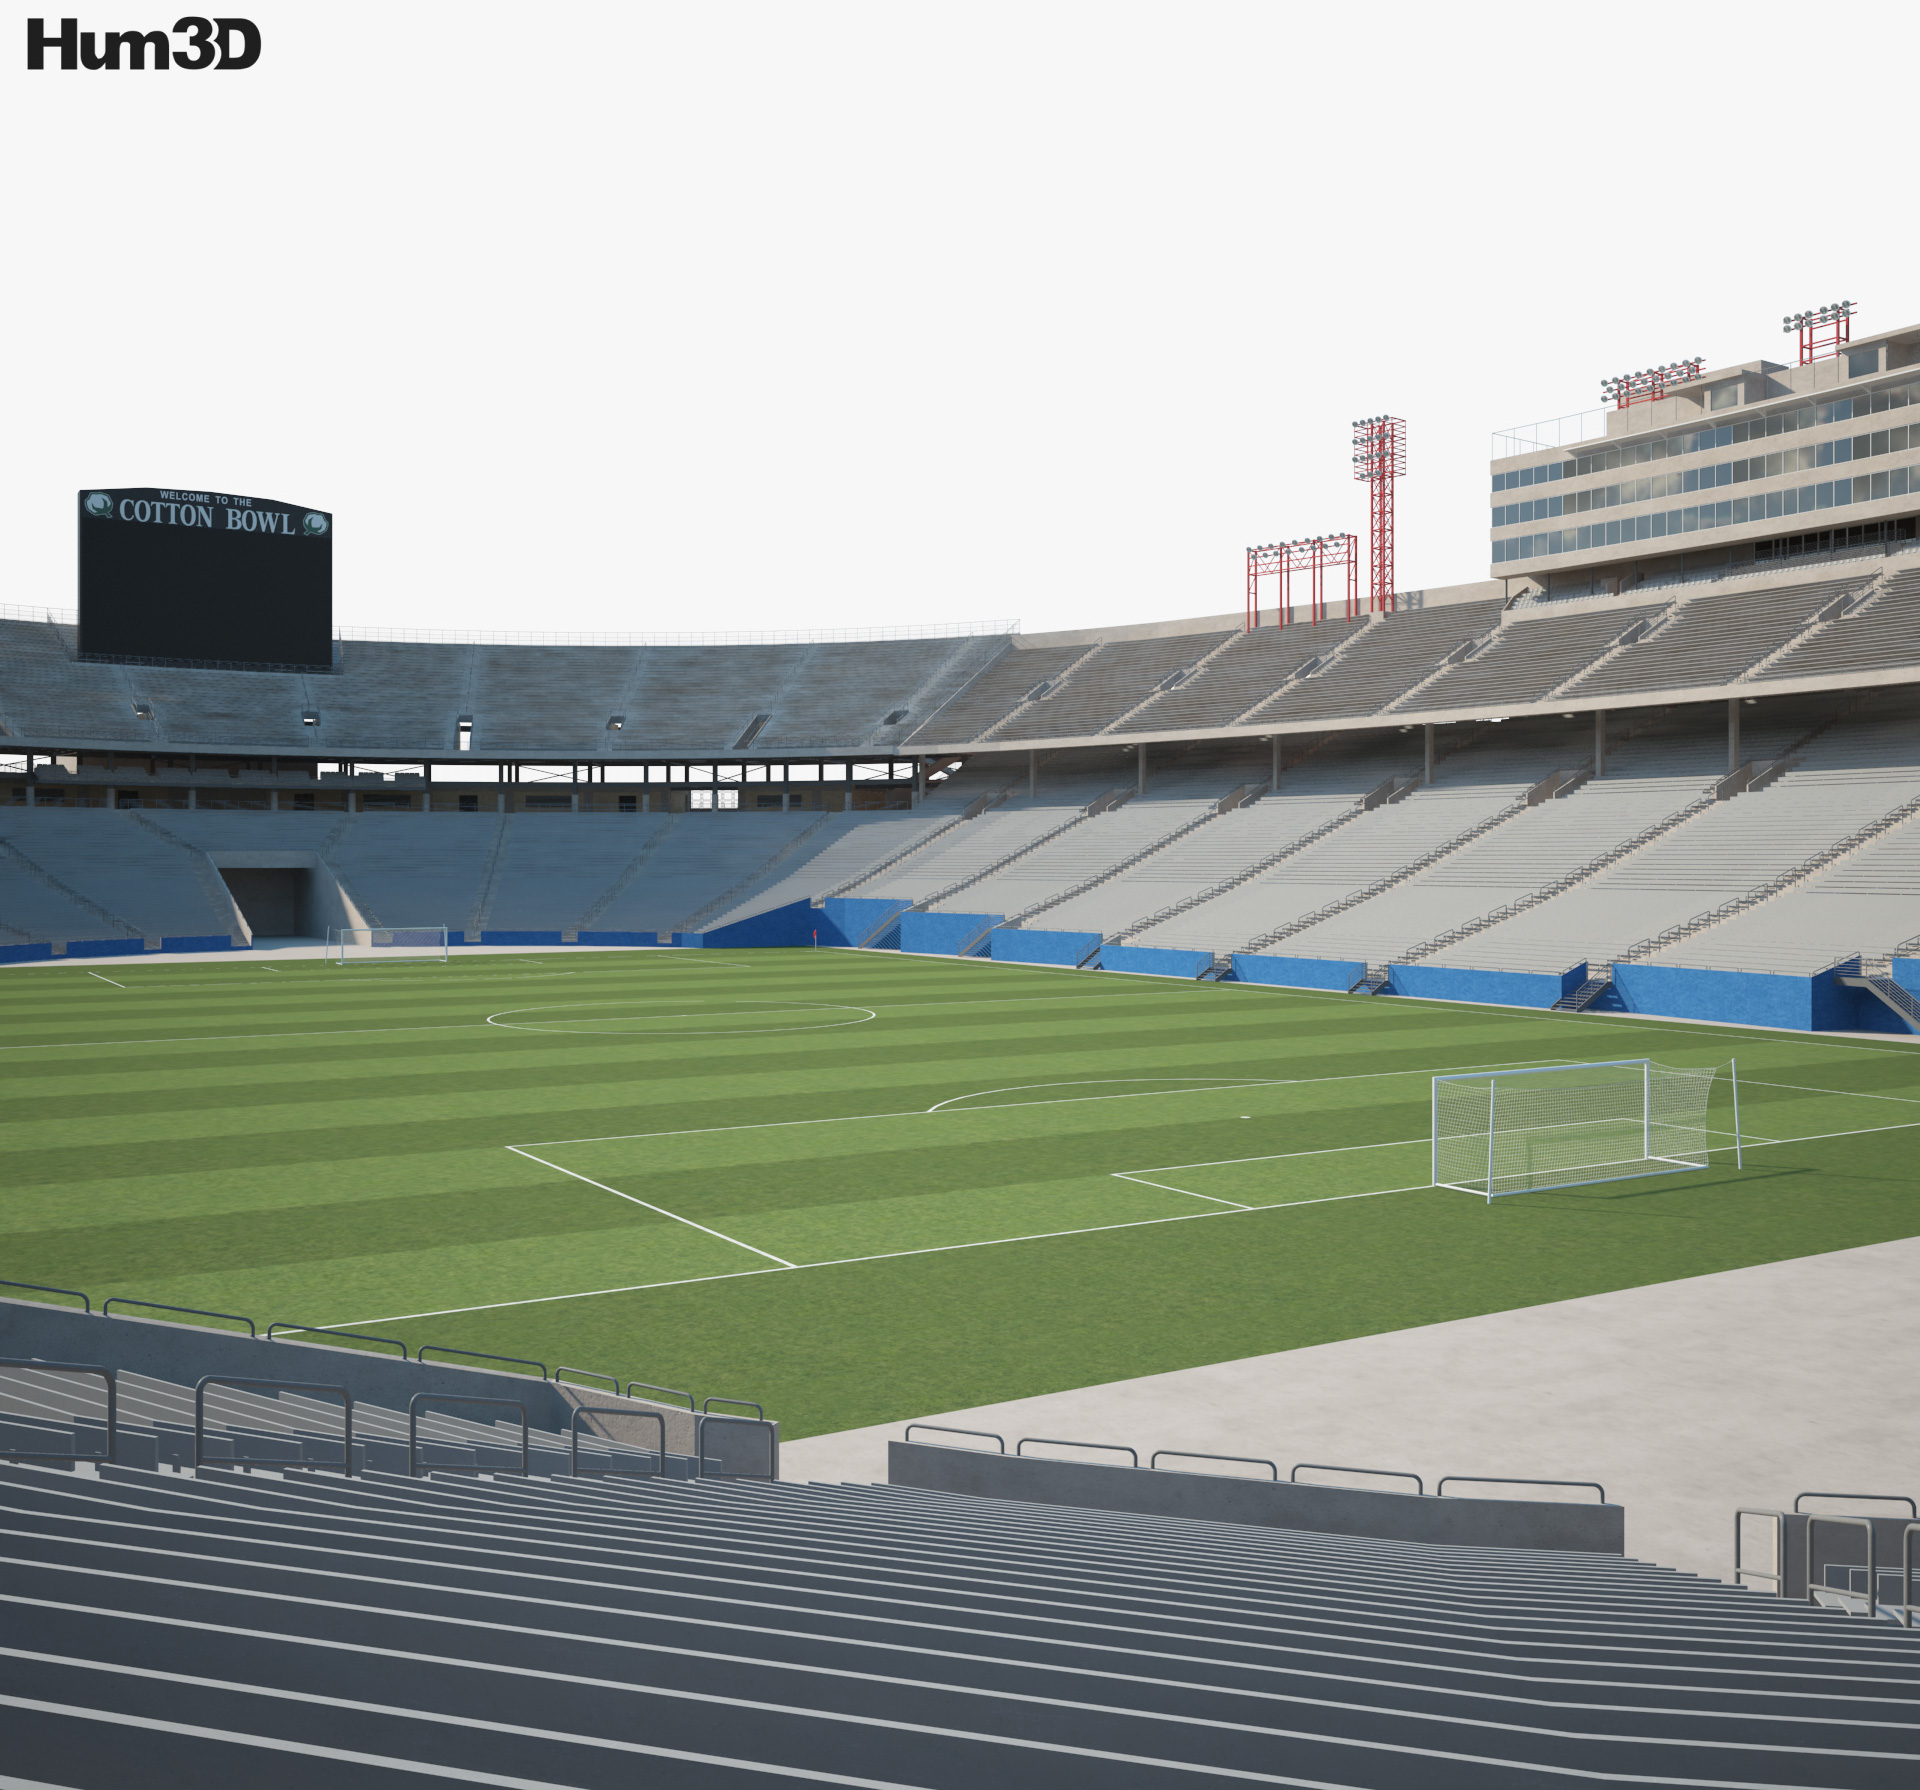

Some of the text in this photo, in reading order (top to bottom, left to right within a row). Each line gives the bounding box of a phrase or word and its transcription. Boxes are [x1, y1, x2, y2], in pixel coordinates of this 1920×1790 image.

[159, 490, 252, 507] WELCOME TO THE
[119, 498, 296, 535] COTTON BOWL
